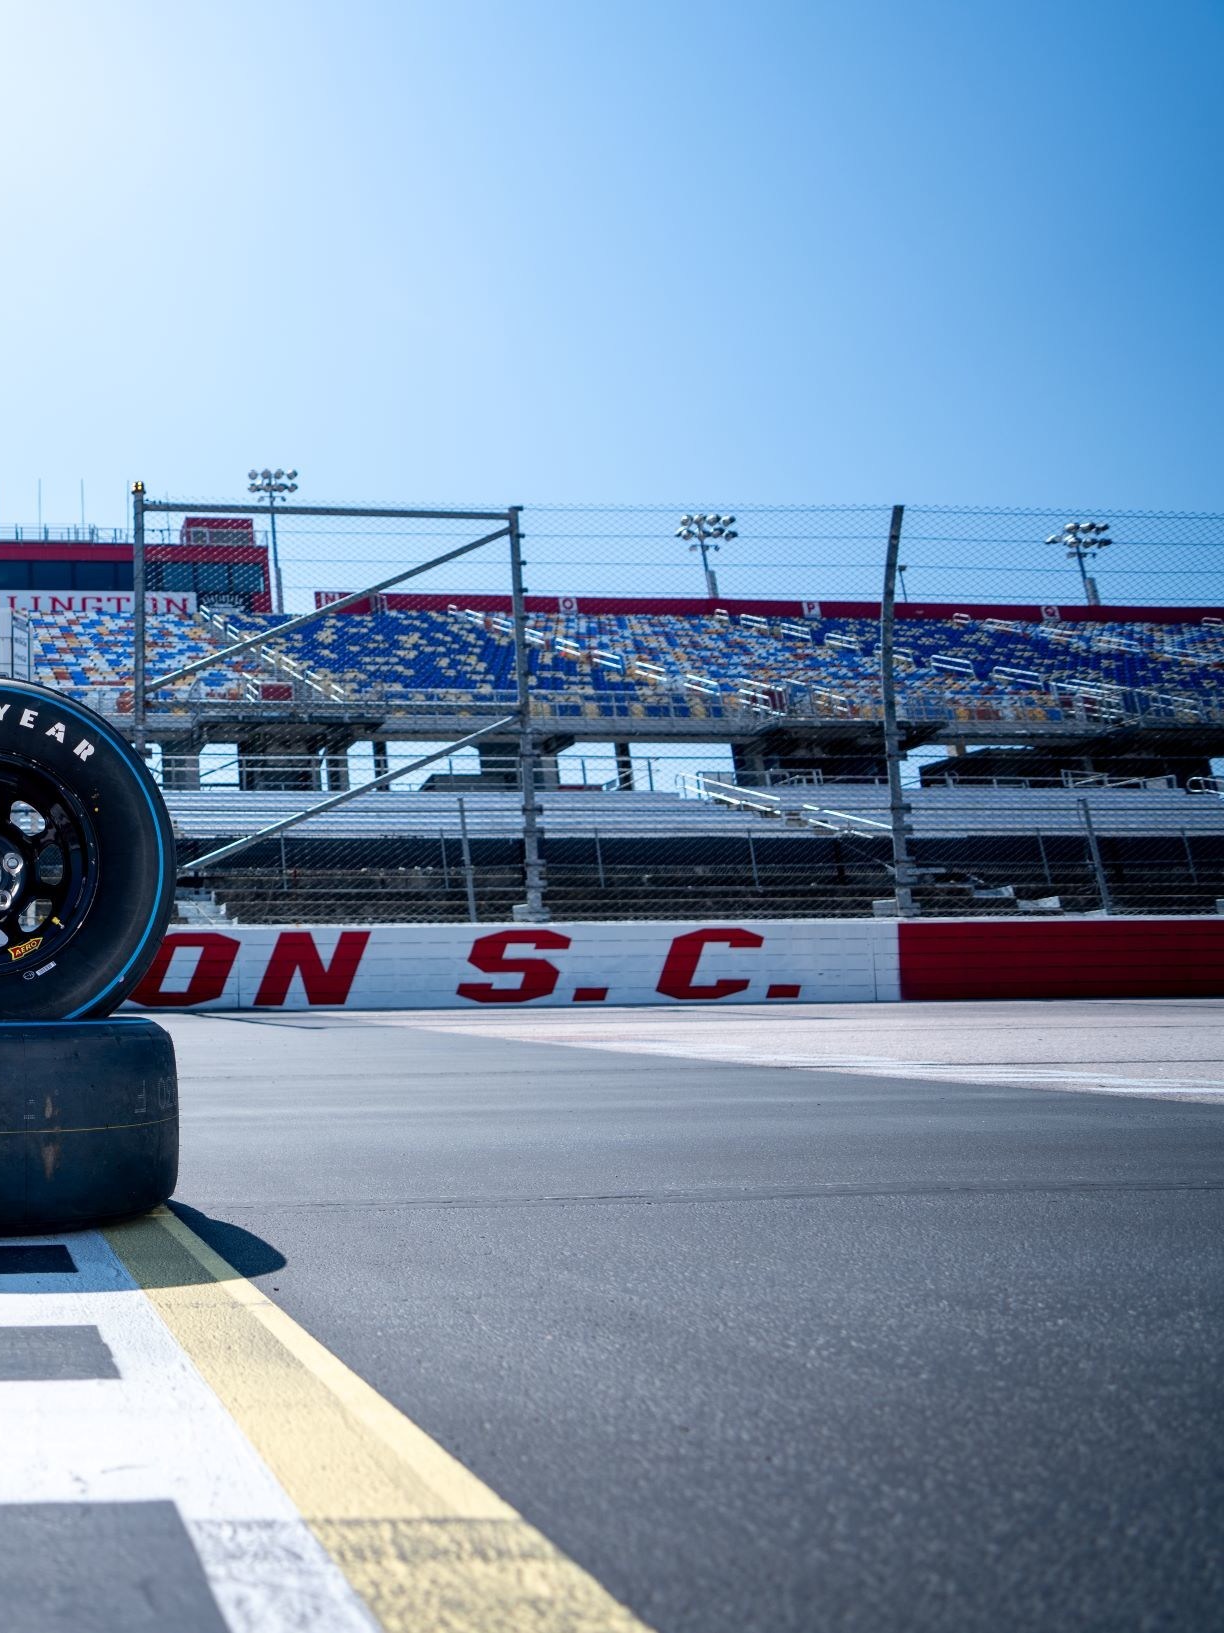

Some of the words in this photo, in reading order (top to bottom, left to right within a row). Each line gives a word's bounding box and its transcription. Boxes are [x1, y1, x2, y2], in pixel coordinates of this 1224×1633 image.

[807, 602, 817, 613] P
[15, 940, 38, 957] AERO
[456, 930, 610, 1003] S.
[656, 928, 802, 1001] C.
